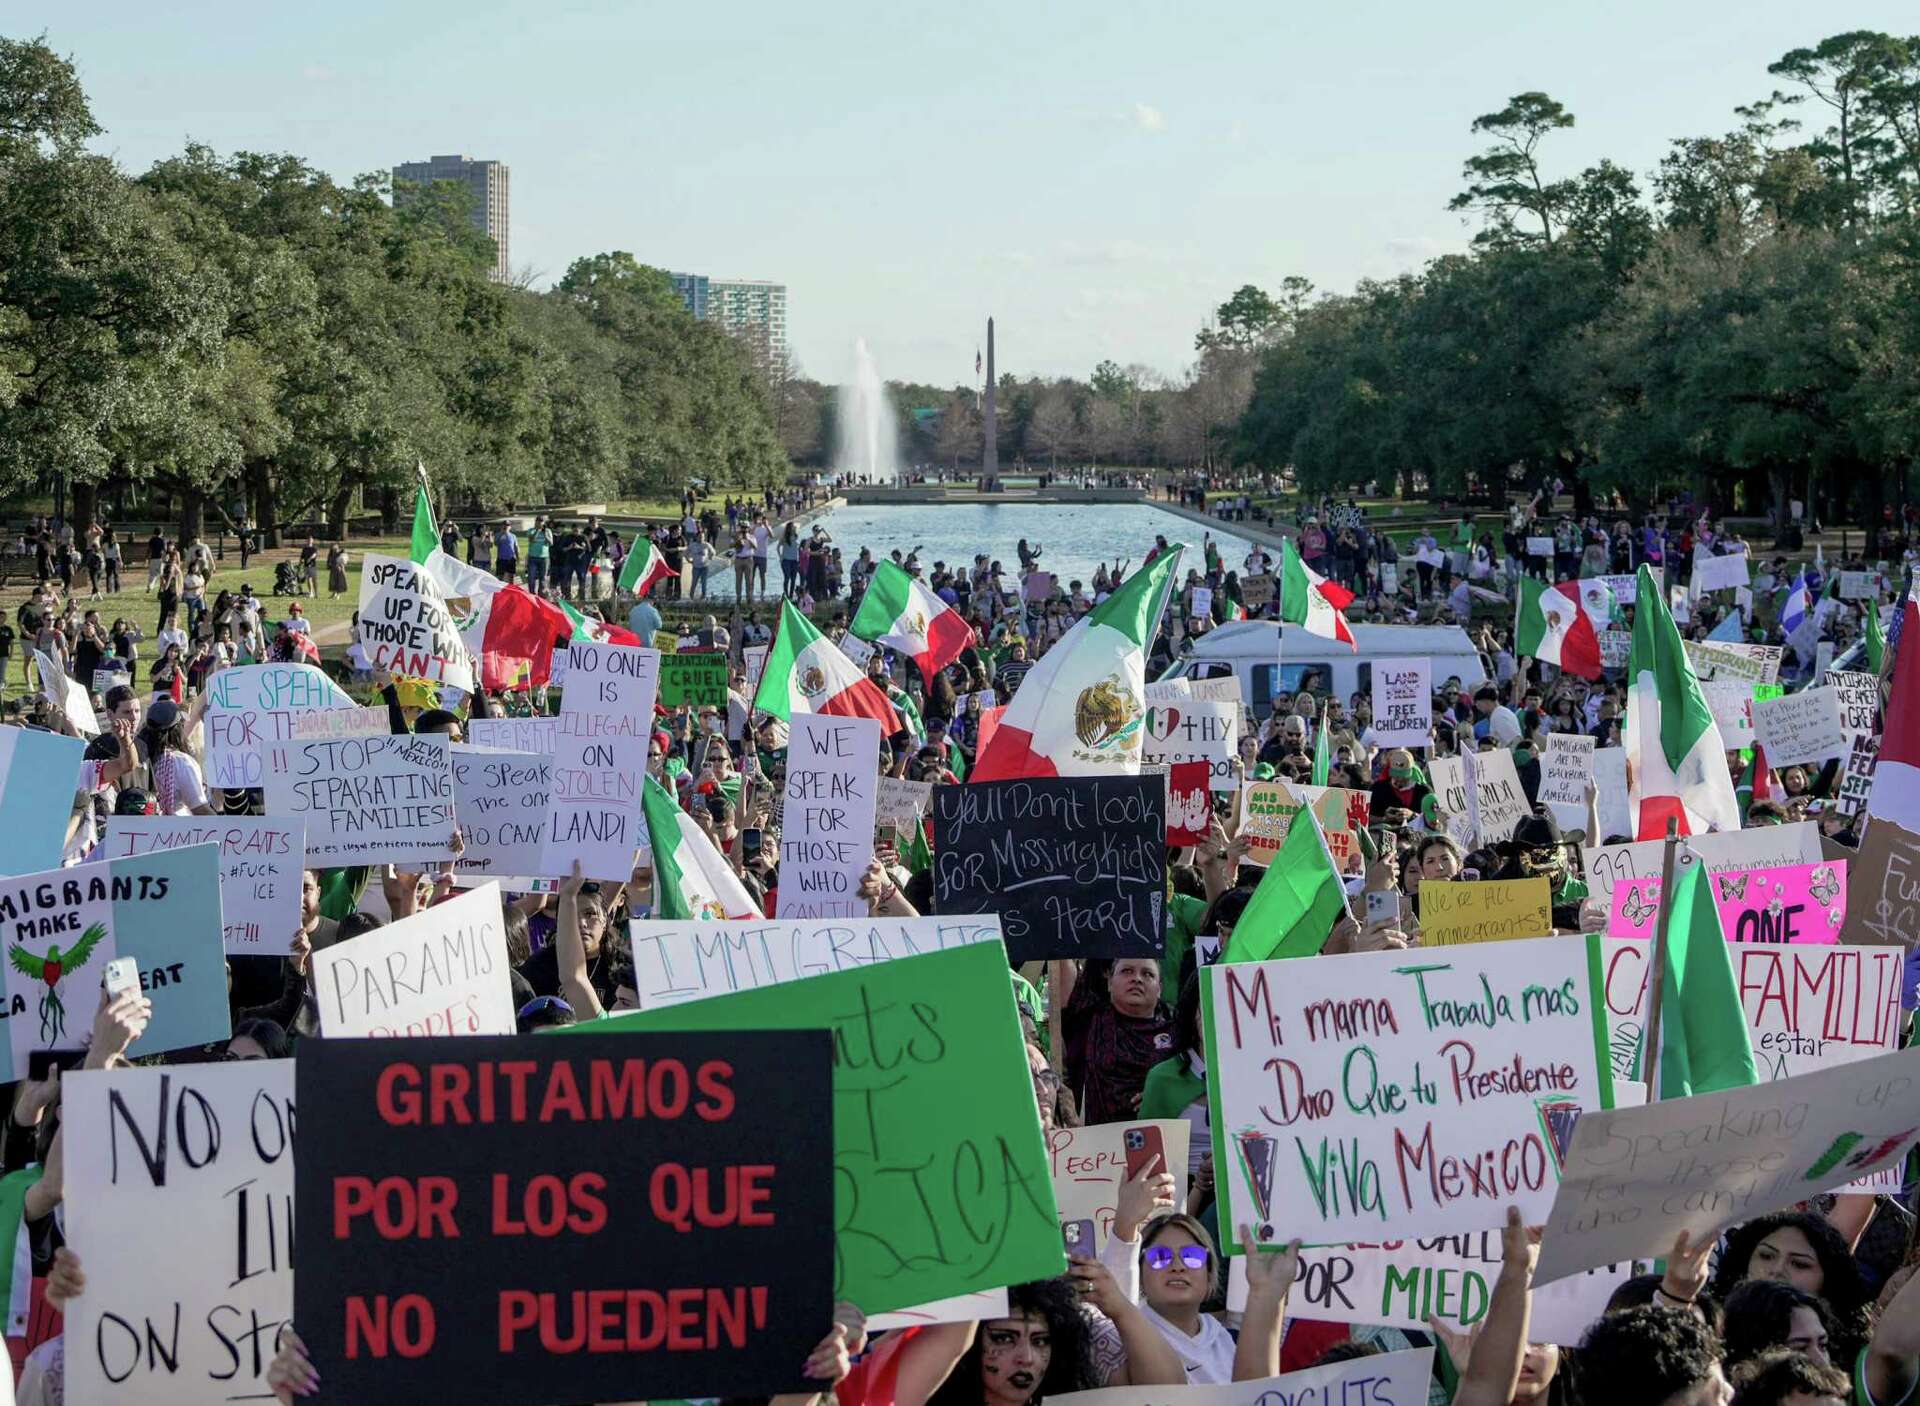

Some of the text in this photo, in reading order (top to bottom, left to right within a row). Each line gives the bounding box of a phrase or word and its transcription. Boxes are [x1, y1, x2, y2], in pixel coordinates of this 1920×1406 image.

[384, 597, 452, 636] UP FOR
[361, 619, 427, 650] THOSE
[569, 646, 598, 672] NO
[606, 650, 653, 679] ONE
[207, 670, 243, 709] WE
[599, 681, 618, 702] IS
[670, 670, 727, 687] CRUEL
[211, 711, 263, 748] FOR
[558, 711, 649, 737] ILLEGAL
[1375, 717, 1428, 732] CHILDREN
[582, 744, 614, 767] ON
[806, 725, 856, 757] WE
[212, 751, 263, 785] WHO
[554, 768, 636, 797] STOLEN
[290, 773, 451, 812] SEPARATING
[788, 770, 864, 801] SPEAK
[1252, 792, 1277, 802] MIS
[1541, 788, 1581, 804] AMERICA
[1559, 780, 1570, 791] OF
[459, 822, 490, 846] HO
[805, 807, 849, 835] FOR
[784, 840, 860, 864] THOSE
[252, 882, 276, 900] ICE
[799, 871, 848, 893] WHO
[16, 911, 82, 942] MAKE
[1224, 965, 1283, 1048] Mi
[1303, 997, 1399, 1042] mama
[1522, 976, 1579, 1024] mas
[1760, 1028, 1833, 1056] estar
[375, 1058, 736, 1127] GRITAMOS
[1259, 1056, 1334, 1127] Duro
[1342, 1043, 1407, 1118] Que
[1408, 1062, 1437, 1106] tu
[1438, 1039, 1579, 1106] Presidente
[108, 1073, 222, 1187] NO
[332, 1175, 460, 1241] POR
[491, 1173, 609, 1238] LOS
[648, 1162, 776, 1233] QUE
[1382, 1263, 1489, 1326] MIED
[343, 1293, 436, 1360] NO
[97, 1302, 181, 1384] ON
